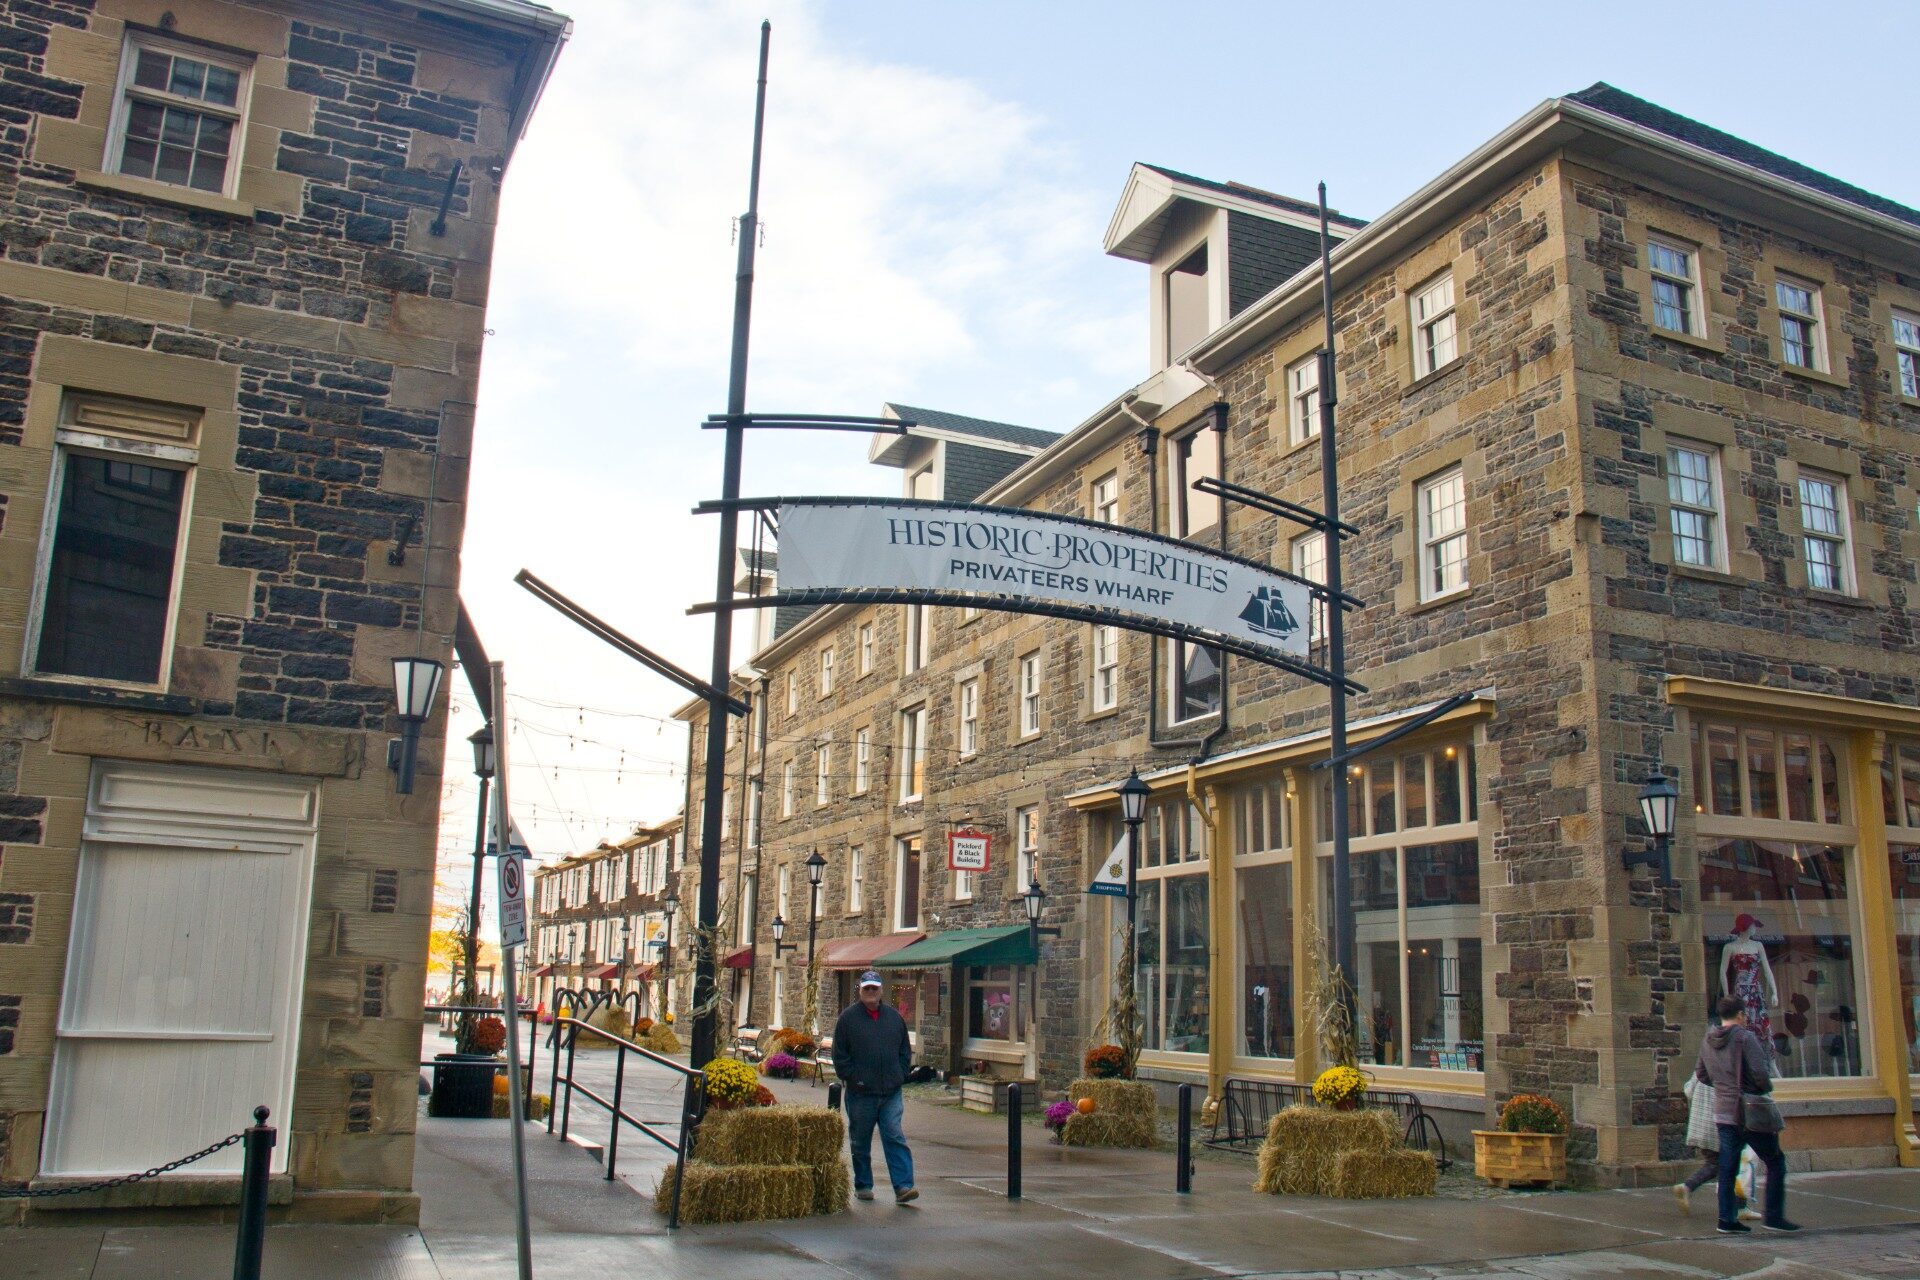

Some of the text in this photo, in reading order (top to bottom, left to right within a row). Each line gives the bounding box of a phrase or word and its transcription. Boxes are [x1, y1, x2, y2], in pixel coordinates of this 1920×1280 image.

[887, 518, 1228, 594] HISTORIC PROPERTIES
[950, 559, 1175, 605] PRIVATEERS WHARF
[957, 842, 982, 850] Pickford
[964, 849, 980, 857] Black
[957, 856, 982, 865] Building
[1095, 884, 1123, 892] SHOPPING
